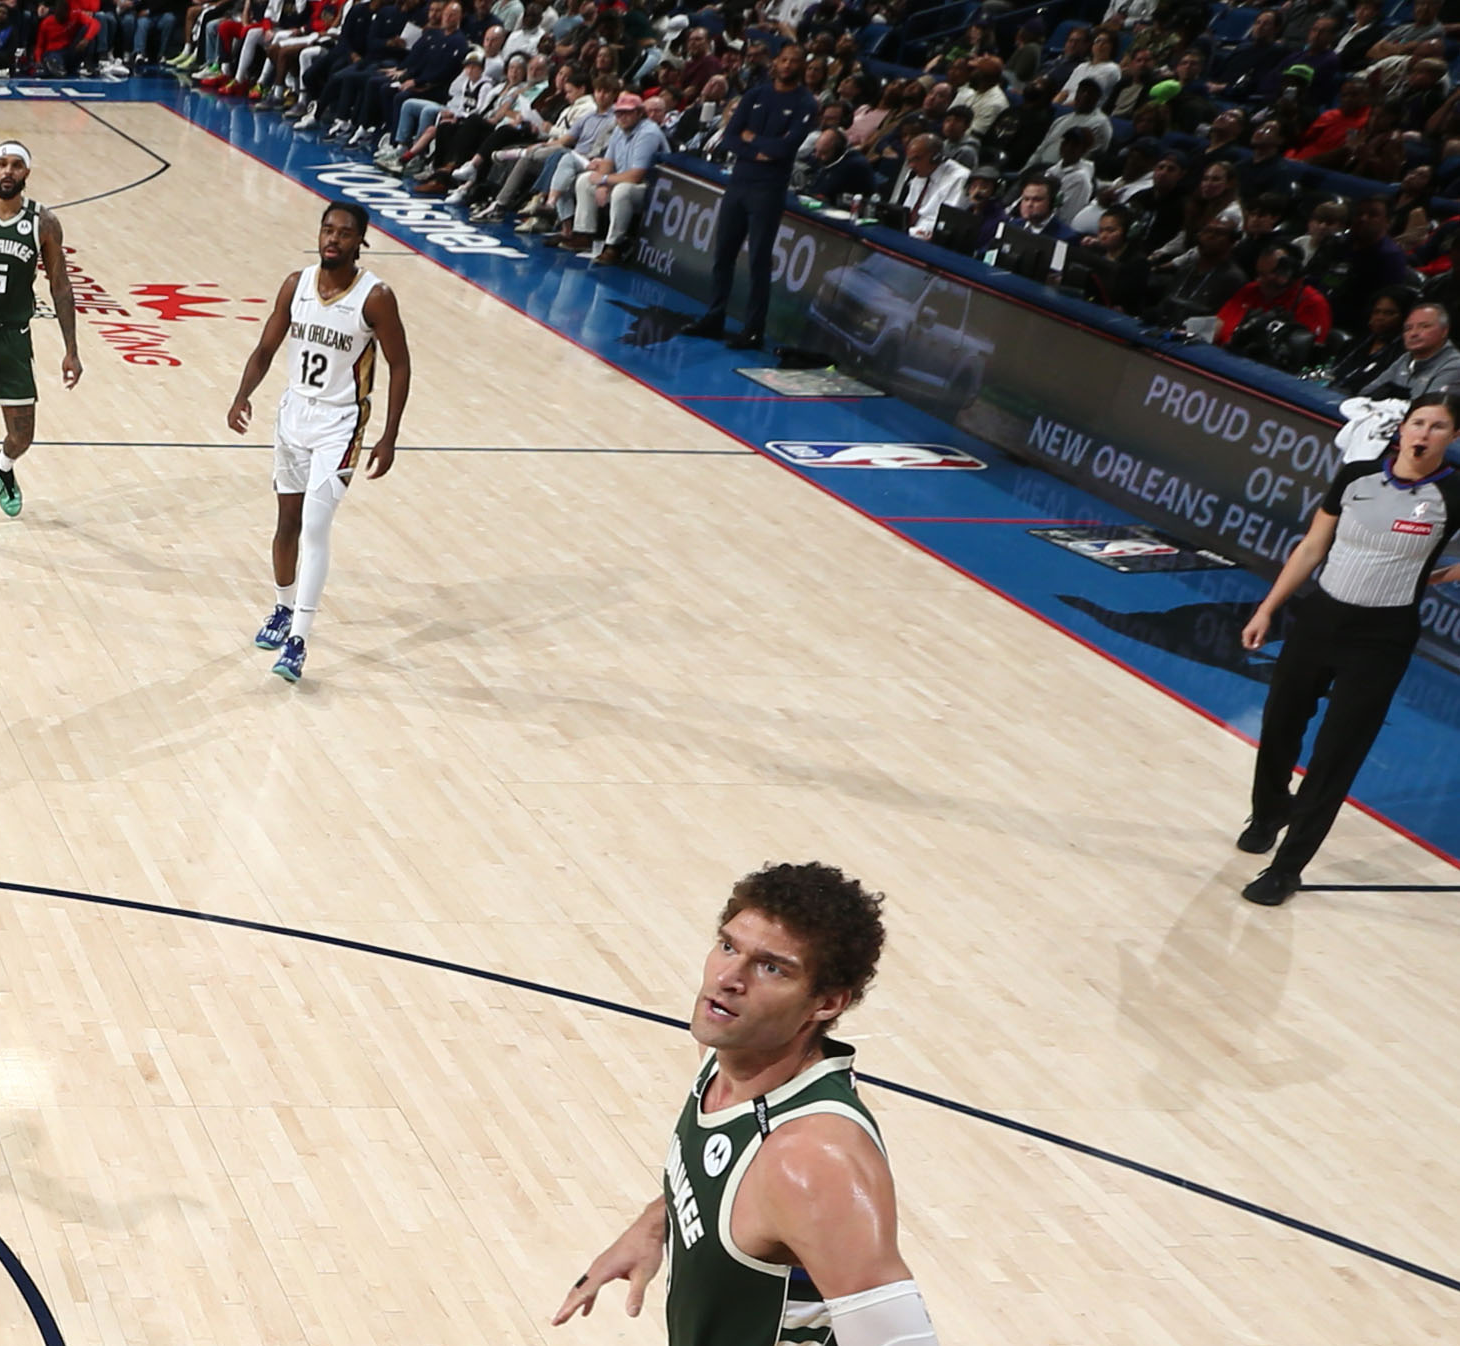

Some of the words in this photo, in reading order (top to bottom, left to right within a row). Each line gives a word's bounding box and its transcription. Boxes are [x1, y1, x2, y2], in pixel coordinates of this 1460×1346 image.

[644, 177, 723, 253] Ford
[637, 237, 676, 277] Truck
[307, 323, 354, 353] ORLEANS
[300, 350, 329, 389] 12
[1144, 375, 1250, 442] PROUD
[1250, 420, 1345, 483] SPON
[1027, 415, 1092, 468] NEW
[1091, 445, 1219, 528] ORLEANS
[1245, 466, 1295, 508] OF
